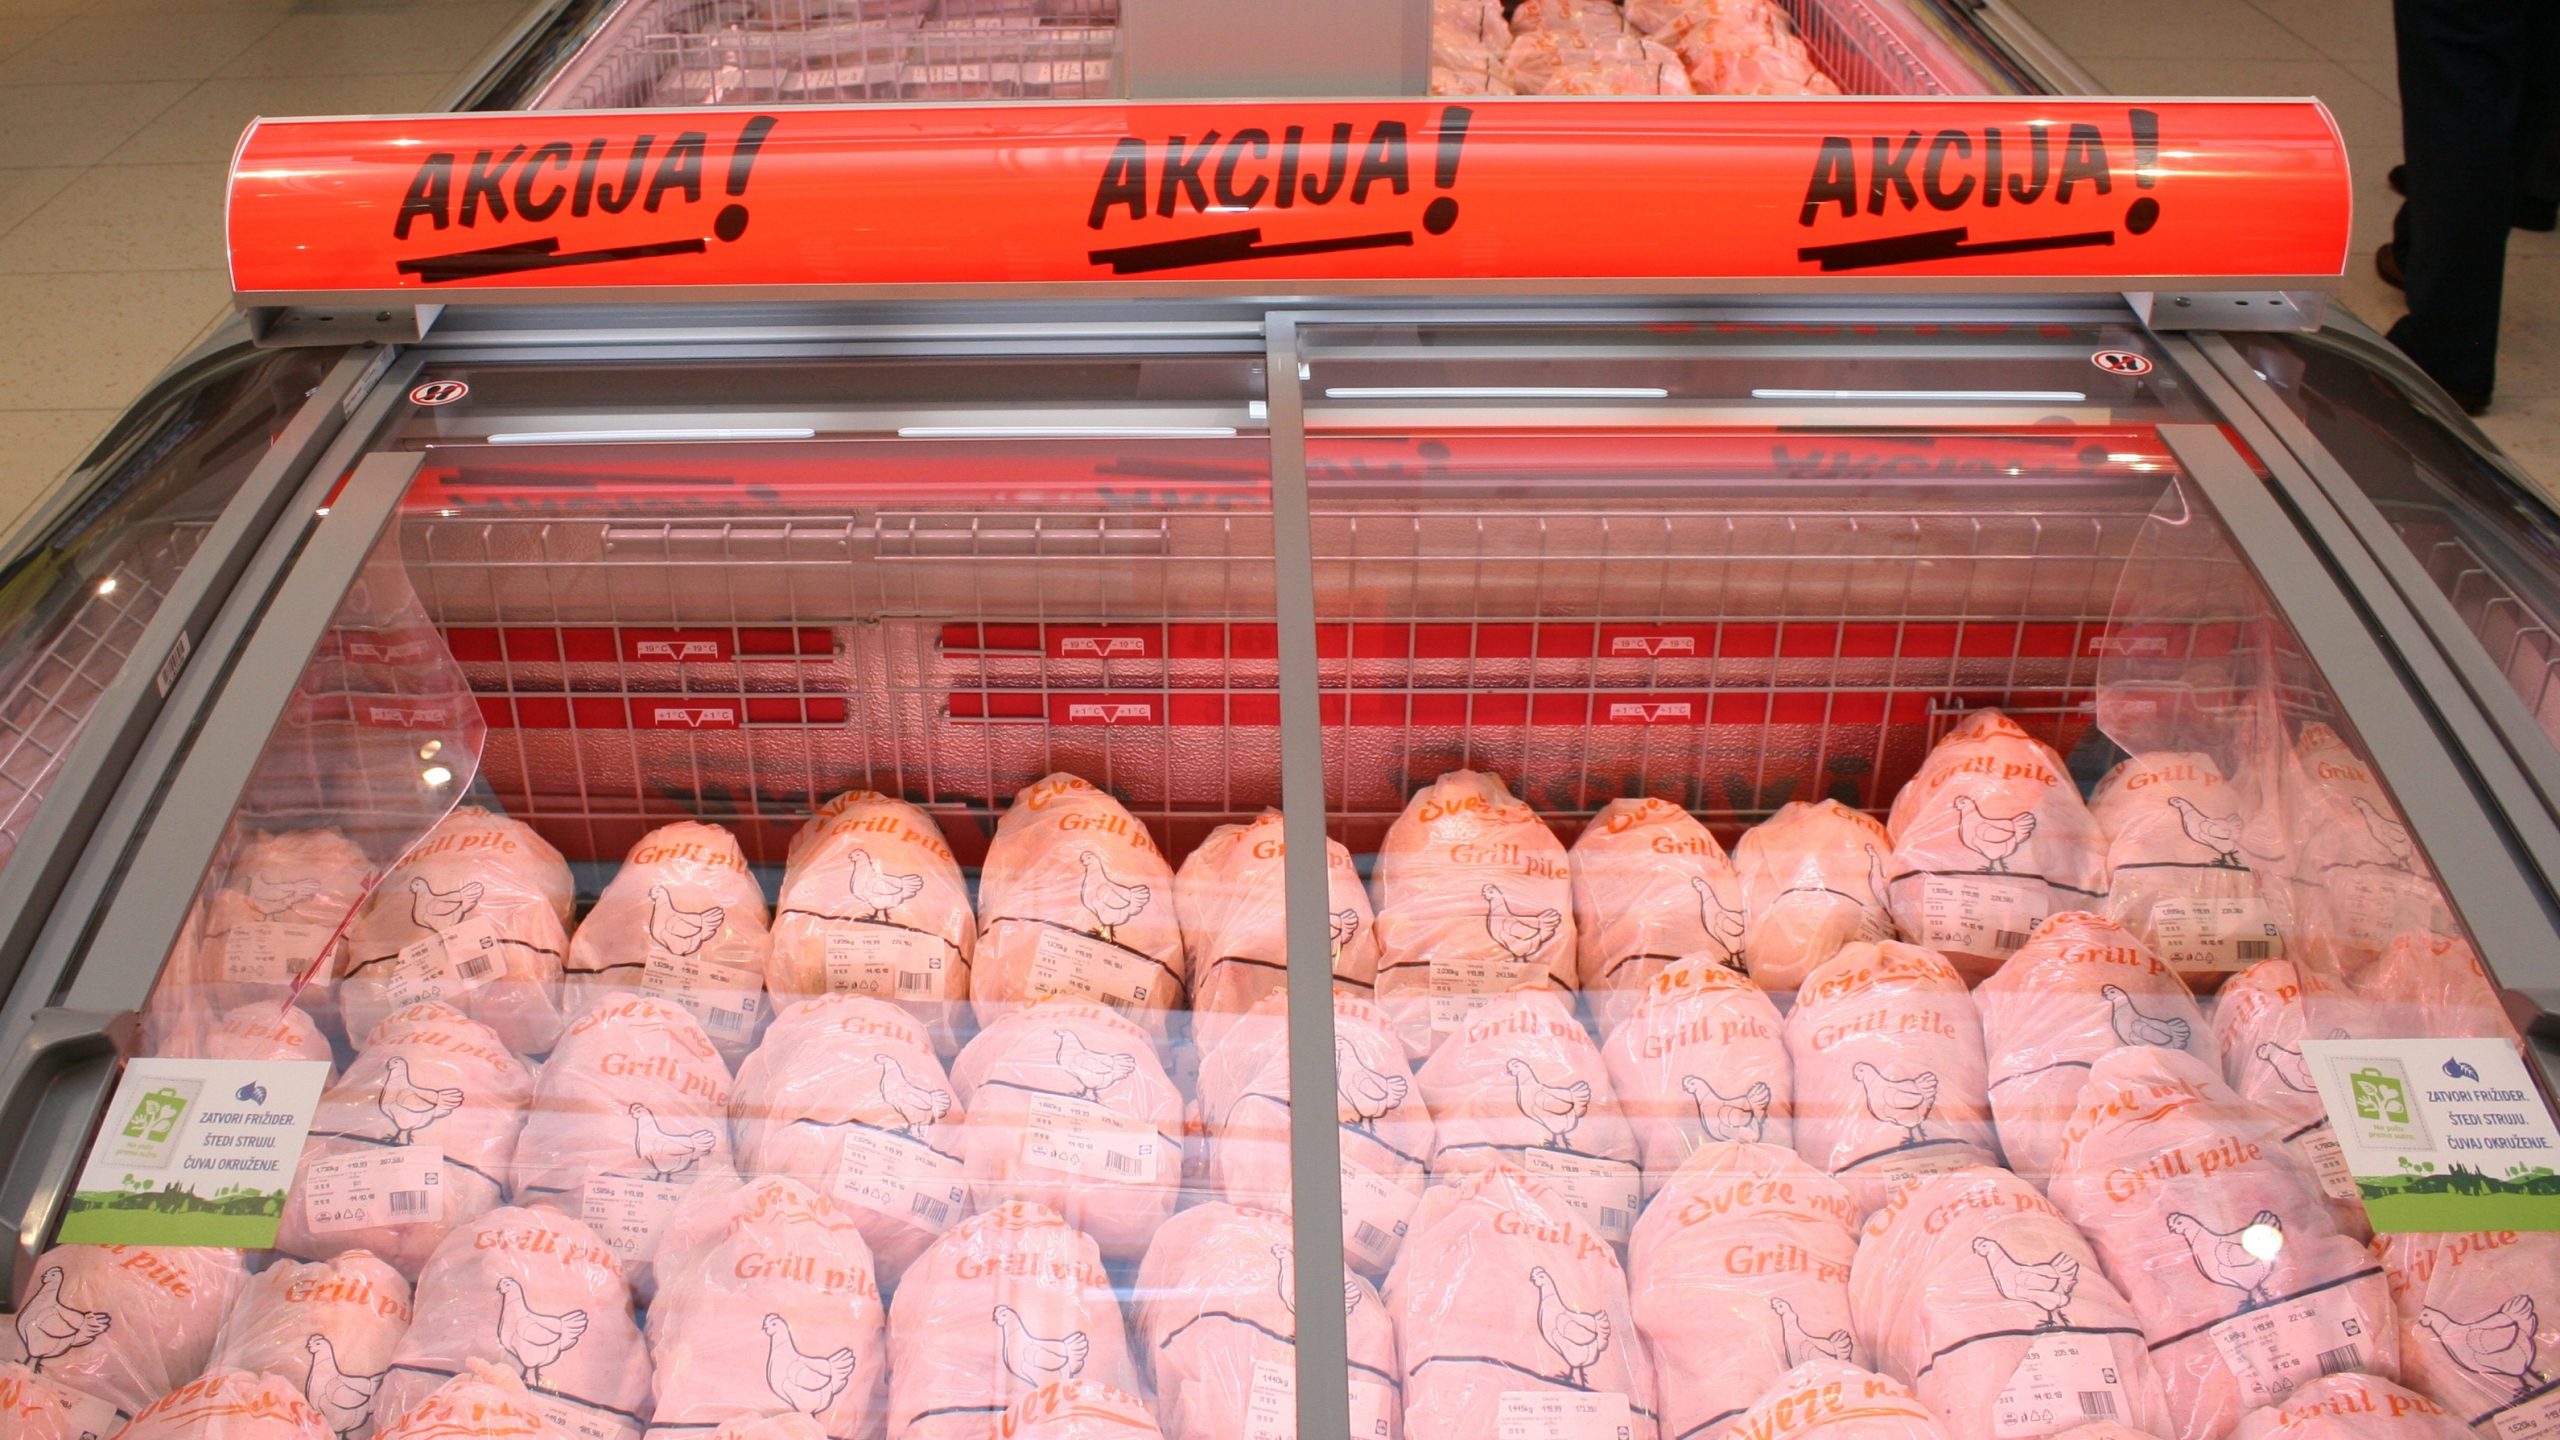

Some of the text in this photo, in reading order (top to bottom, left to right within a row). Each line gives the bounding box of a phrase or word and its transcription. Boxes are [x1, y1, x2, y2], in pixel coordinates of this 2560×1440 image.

[393, 115, 779, 242] AKCIJA!
[1087, 106, 1474, 236] AKCIJA!
[1798, 108, 2160, 236] AKCIJA!
[1931, 756, 2059, 789] Grill pile
[2126, 764, 2198, 791] Grill
[830, 816, 954, 863] Grill pile
[1059, 812, 1129, 837] Grill
[459, 829, 519, 855] pile
[633, 840, 703, 867] Grill
[1651, 836, 1718, 858] Grill
[1450, 843, 1569, 881] Grill pile
[2057, 946, 2141, 968] Grill
[1334, 1000, 1374, 1023] ill
[840, 1014, 915, 1045] Grill
[1643, 1015, 1771, 1059] Grill pile
[1812, 1009, 1957, 1051] Grill pile
[453, 1041, 509, 1075] pile
[600, 1051, 729, 1109] Grill pile
[2426, 1087, 2531, 1103] ZATVORI FRIŽIDER.
[200, 1110, 296, 1127] ZATVORI FRIŽIDER.
[2449, 1110, 2530, 1126] ŠTEDI STRUJU.
[203, 1132, 277, 1149] ŠTEDI STRUJU.
[2447, 1134, 2554, 1150] ČUVAJ OKRUŽENJE.
[183, 1154, 281, 1172] ČUVAJ OKRUŽENJE.
[2104, 1135, 2264, 1204] Grill pile
[474, 1227, 561, 1256] Grill
[955, 1250, 1042, 1282] Grill
[1724, 1243, 1809, 1276] Grill
[284, 1277, 372, 1307] Grill
[733, 1251, 880, 1303] Grill pile
